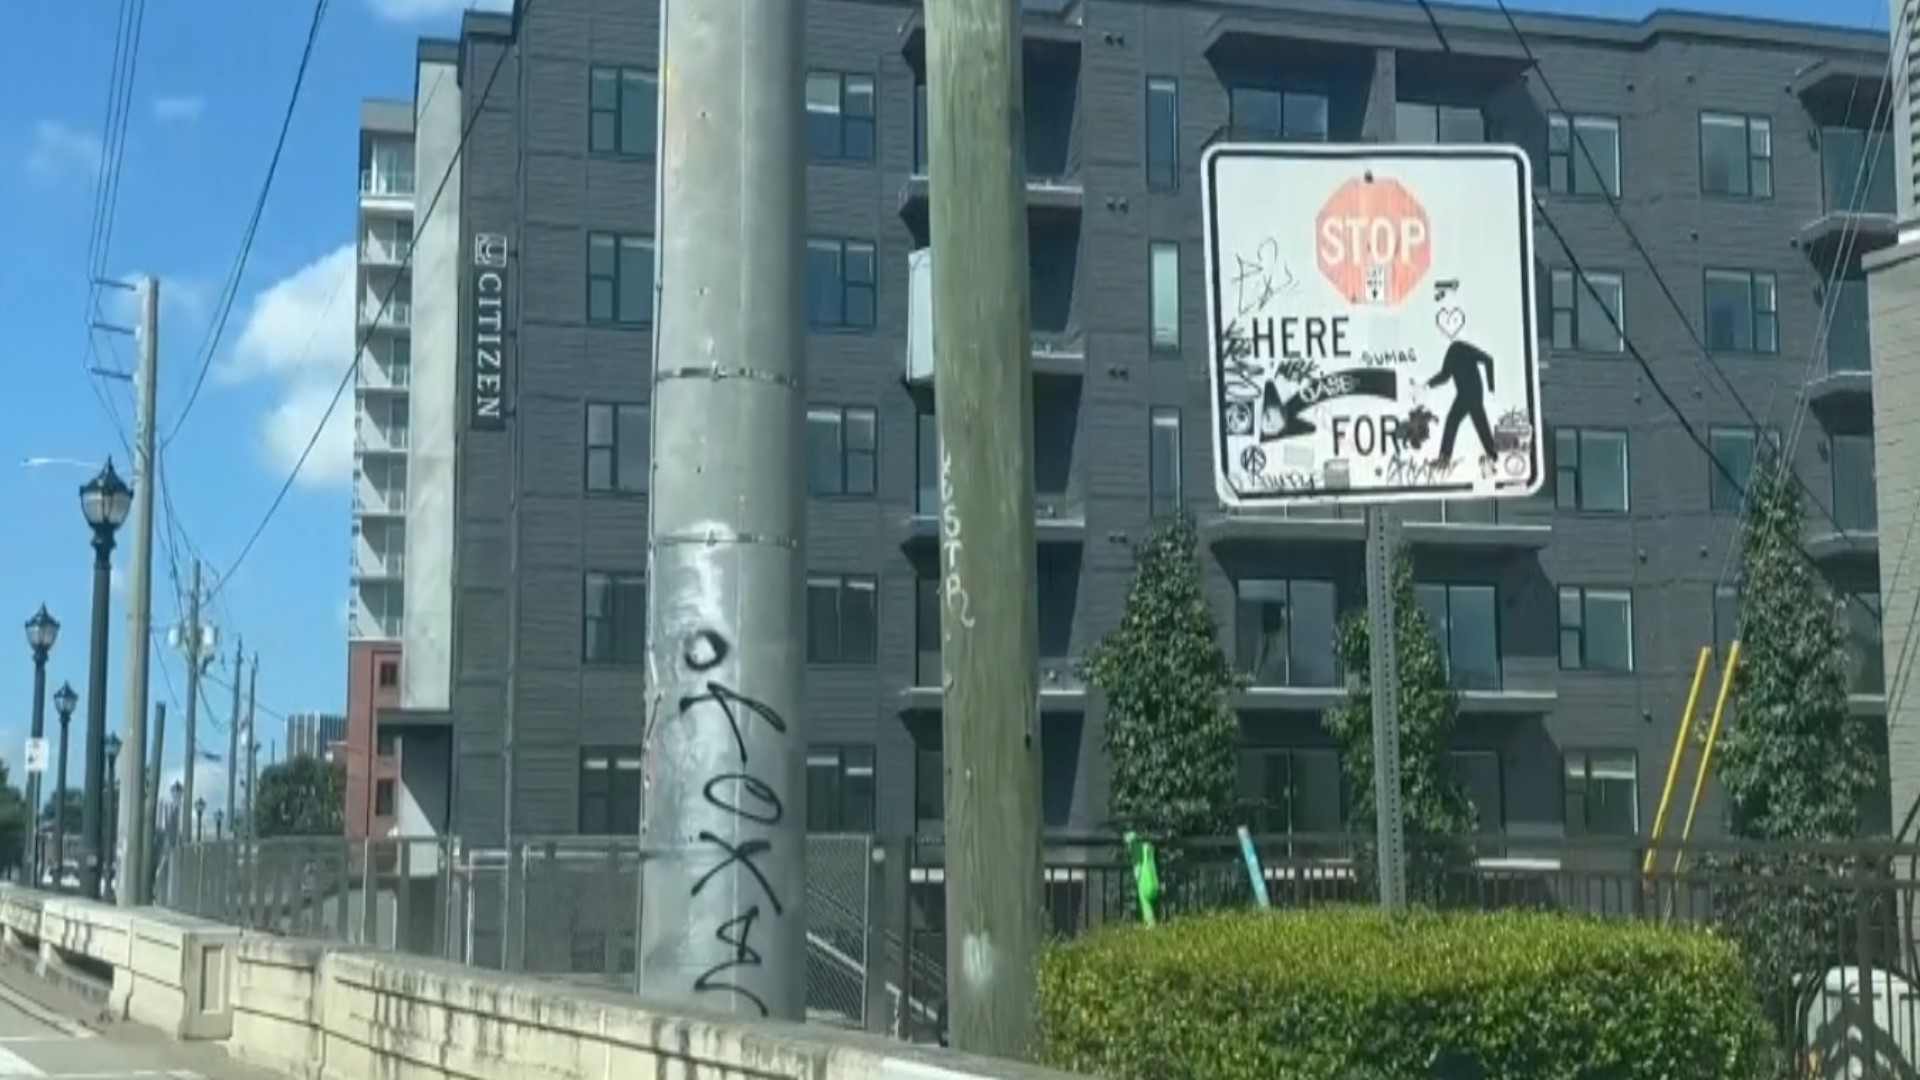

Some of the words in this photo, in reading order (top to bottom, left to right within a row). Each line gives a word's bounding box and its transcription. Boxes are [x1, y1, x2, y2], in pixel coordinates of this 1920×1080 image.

[1322, 217, 1425, 265] STOP
[477, 272, 502, 419] CITIZEN
[1252, 315, 1351, 359] HERE
[1332, 414, 1401, 457] FOR
